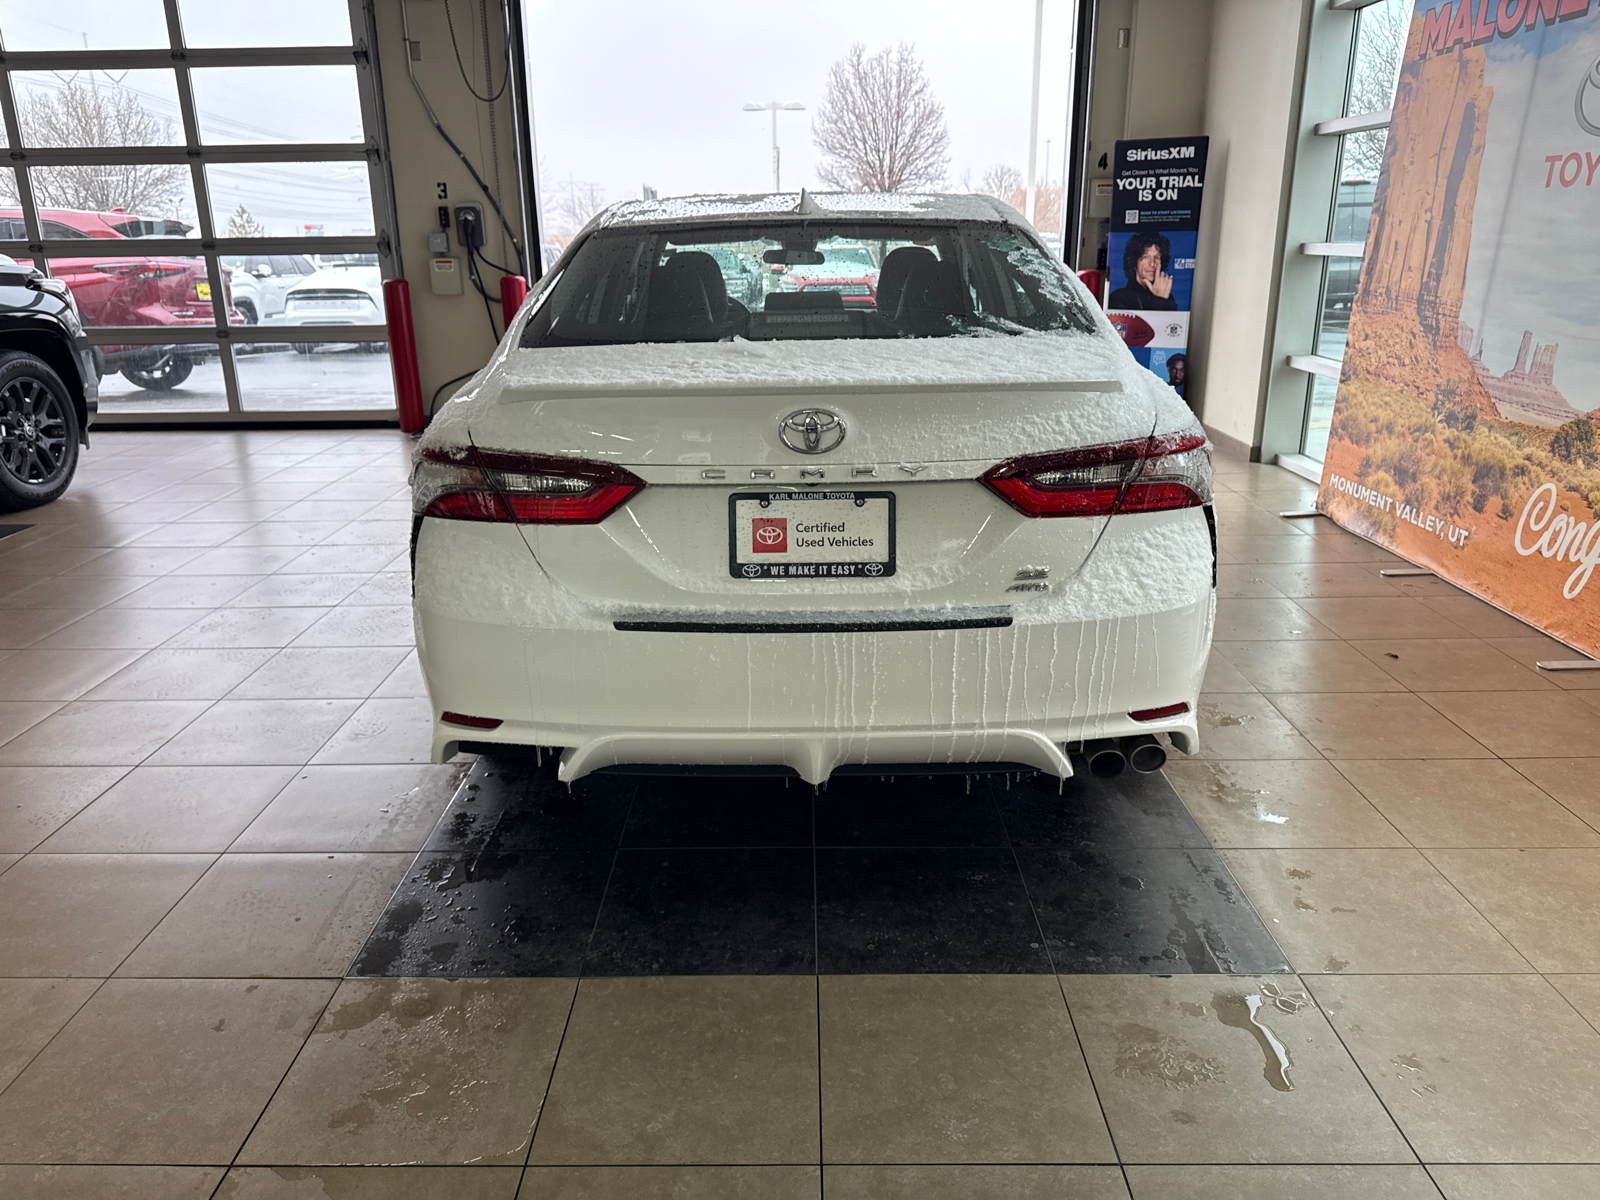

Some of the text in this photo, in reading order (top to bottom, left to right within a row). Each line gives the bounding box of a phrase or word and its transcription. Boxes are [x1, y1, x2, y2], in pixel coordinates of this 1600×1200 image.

[1419, 0, 1590, 59] MALON
[1098, 152, 1108, 170] 4
[1126, 146, 1196, 161] SiriusXM
[1116, 175, 1203, 190] YOUR TRIAL
[437, 182, 448, 199] 3
[1138, 188, 1178, 202] IS ON
[701, 465, 929, 480] CAMRY
[825, 492, 855, 500] TOYOTA
[1329, 473, 1469, 547] MONUMENT VALLEY, UT
[796, 522, 845, 533] Certified
[796, 536, 874, 547] Used Vehicles
[770, 565, 856, 575] WE MAKE IT EASY
